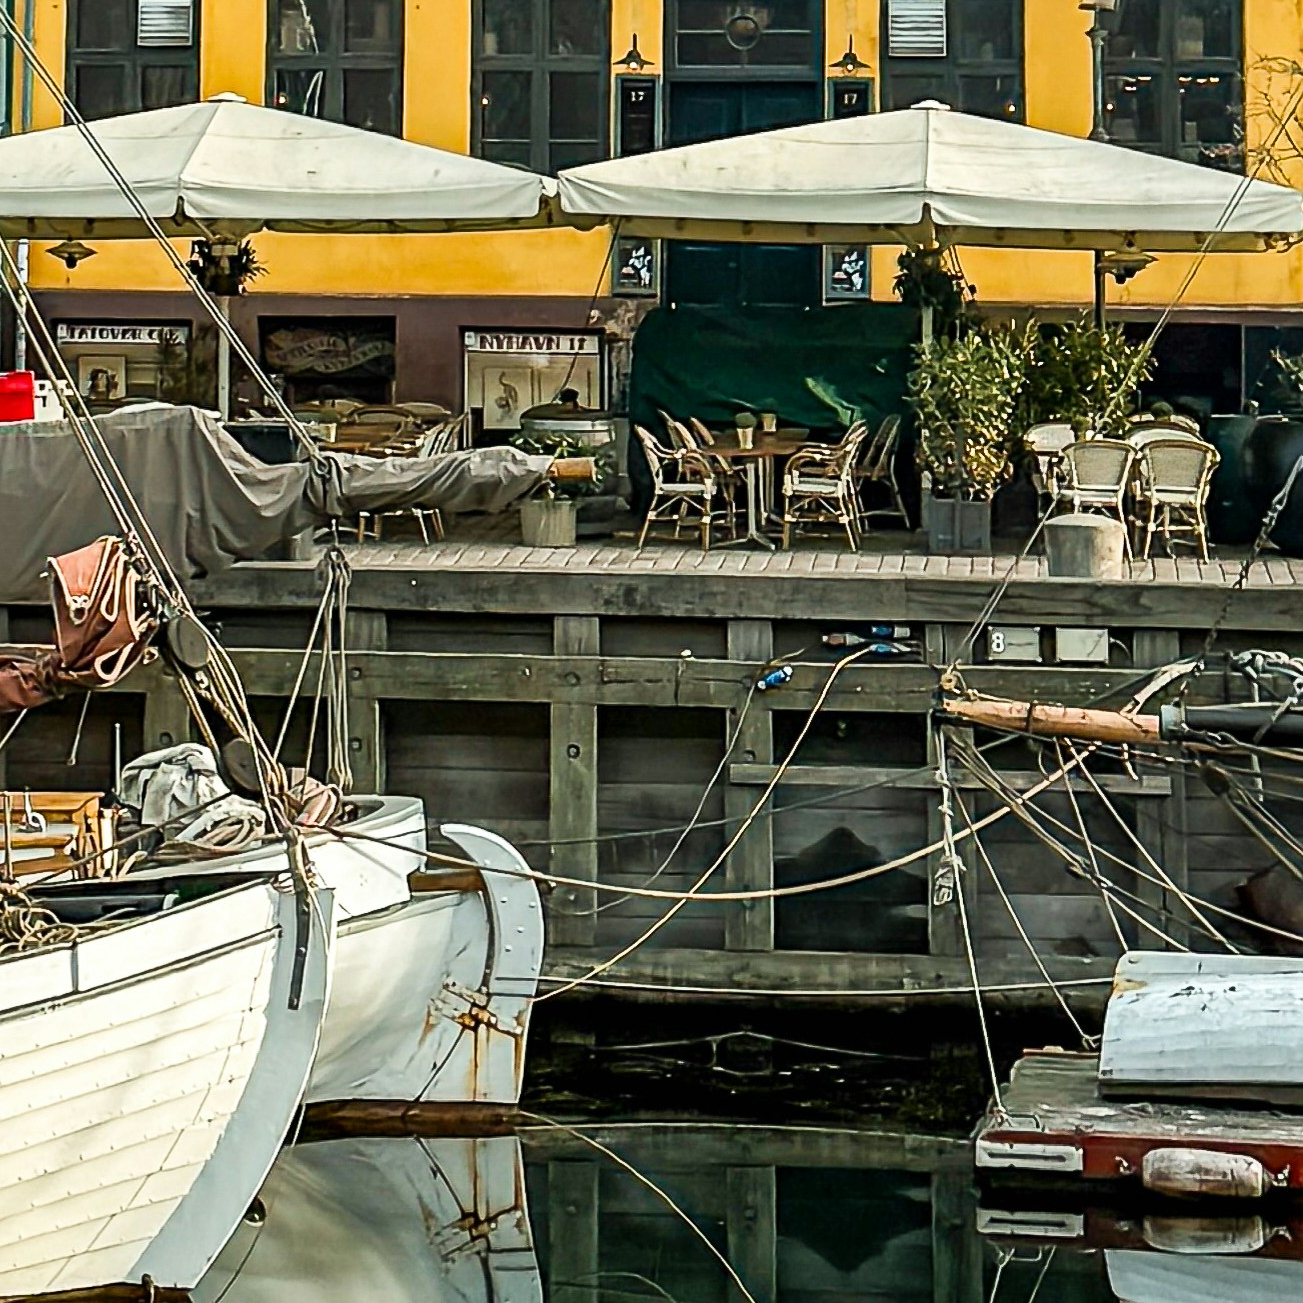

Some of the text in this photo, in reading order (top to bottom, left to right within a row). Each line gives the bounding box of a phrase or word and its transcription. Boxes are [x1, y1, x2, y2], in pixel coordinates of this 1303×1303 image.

[844, 93, 857, 104] 17
[479, 335, 561, 350] NYHAVN
[991, 632, 1005, 653] 8
